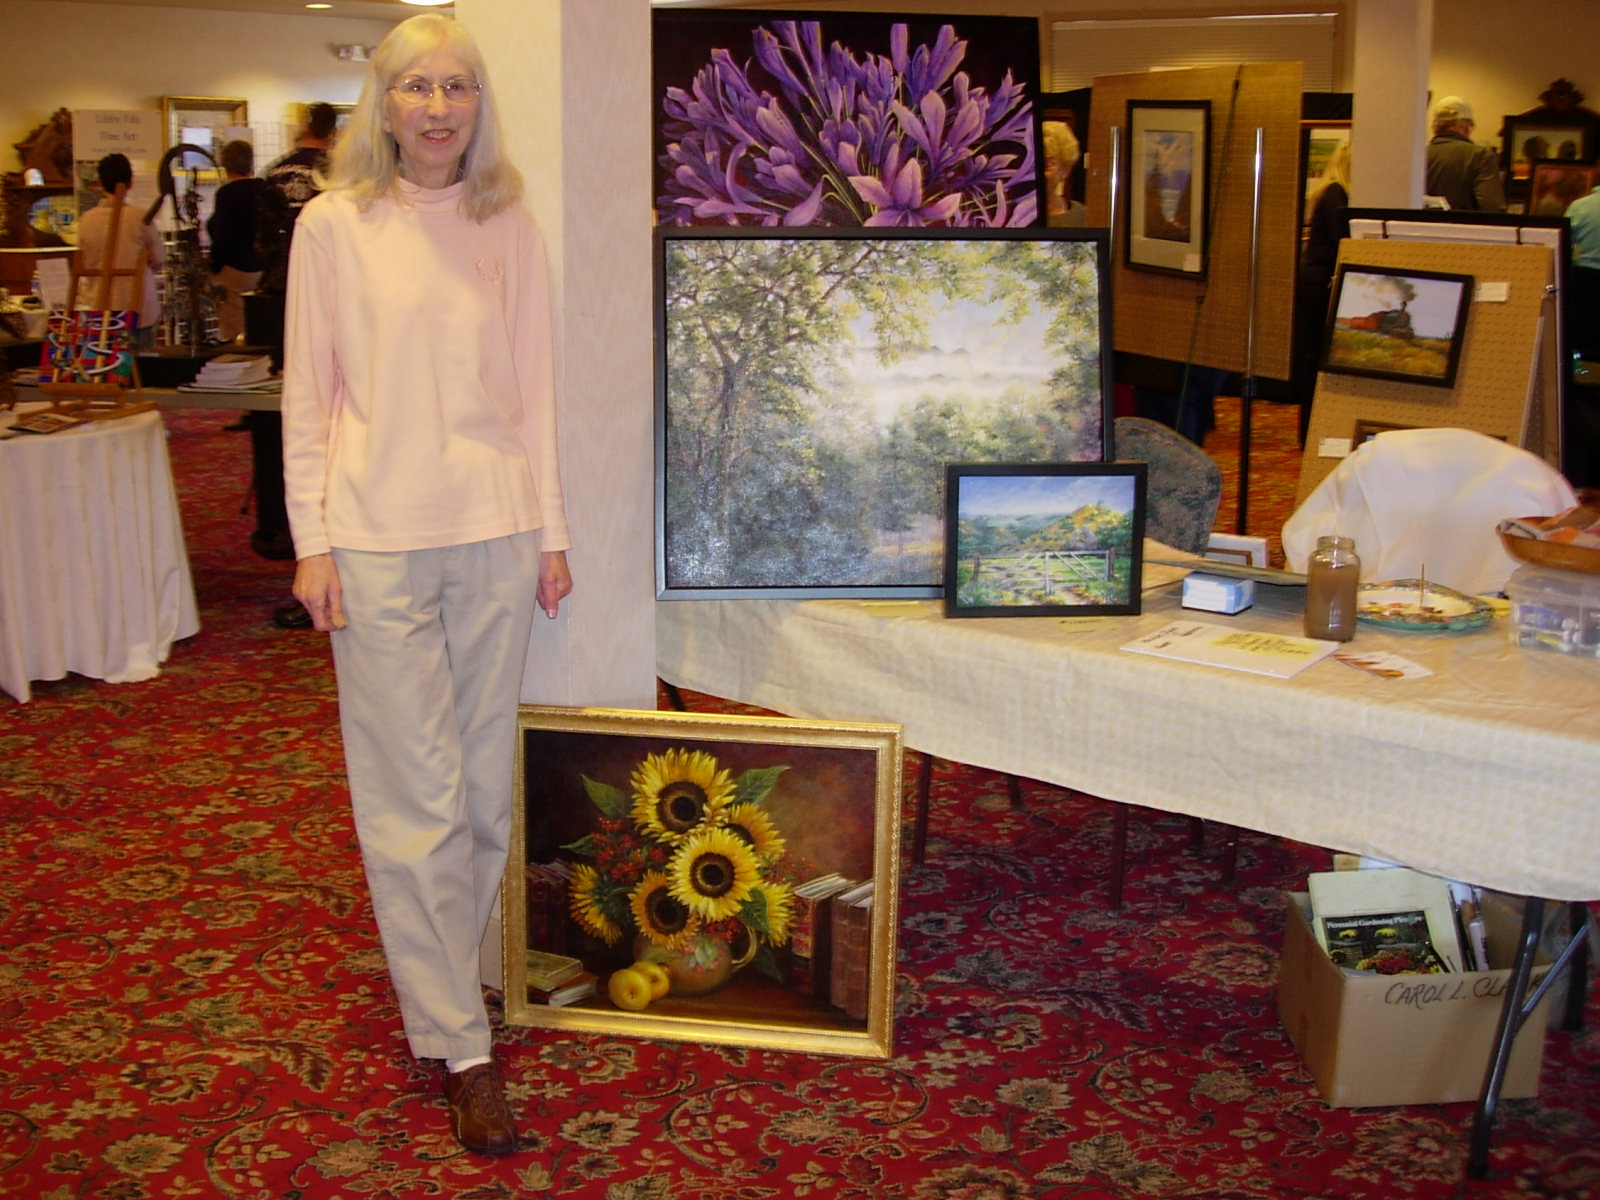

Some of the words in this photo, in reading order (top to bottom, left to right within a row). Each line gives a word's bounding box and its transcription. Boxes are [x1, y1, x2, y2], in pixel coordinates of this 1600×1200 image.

[99, 130, 120, 141] Fine
[123, 130, 137, 141] Art
[1384, 982, 1447, 1010] CAROL
